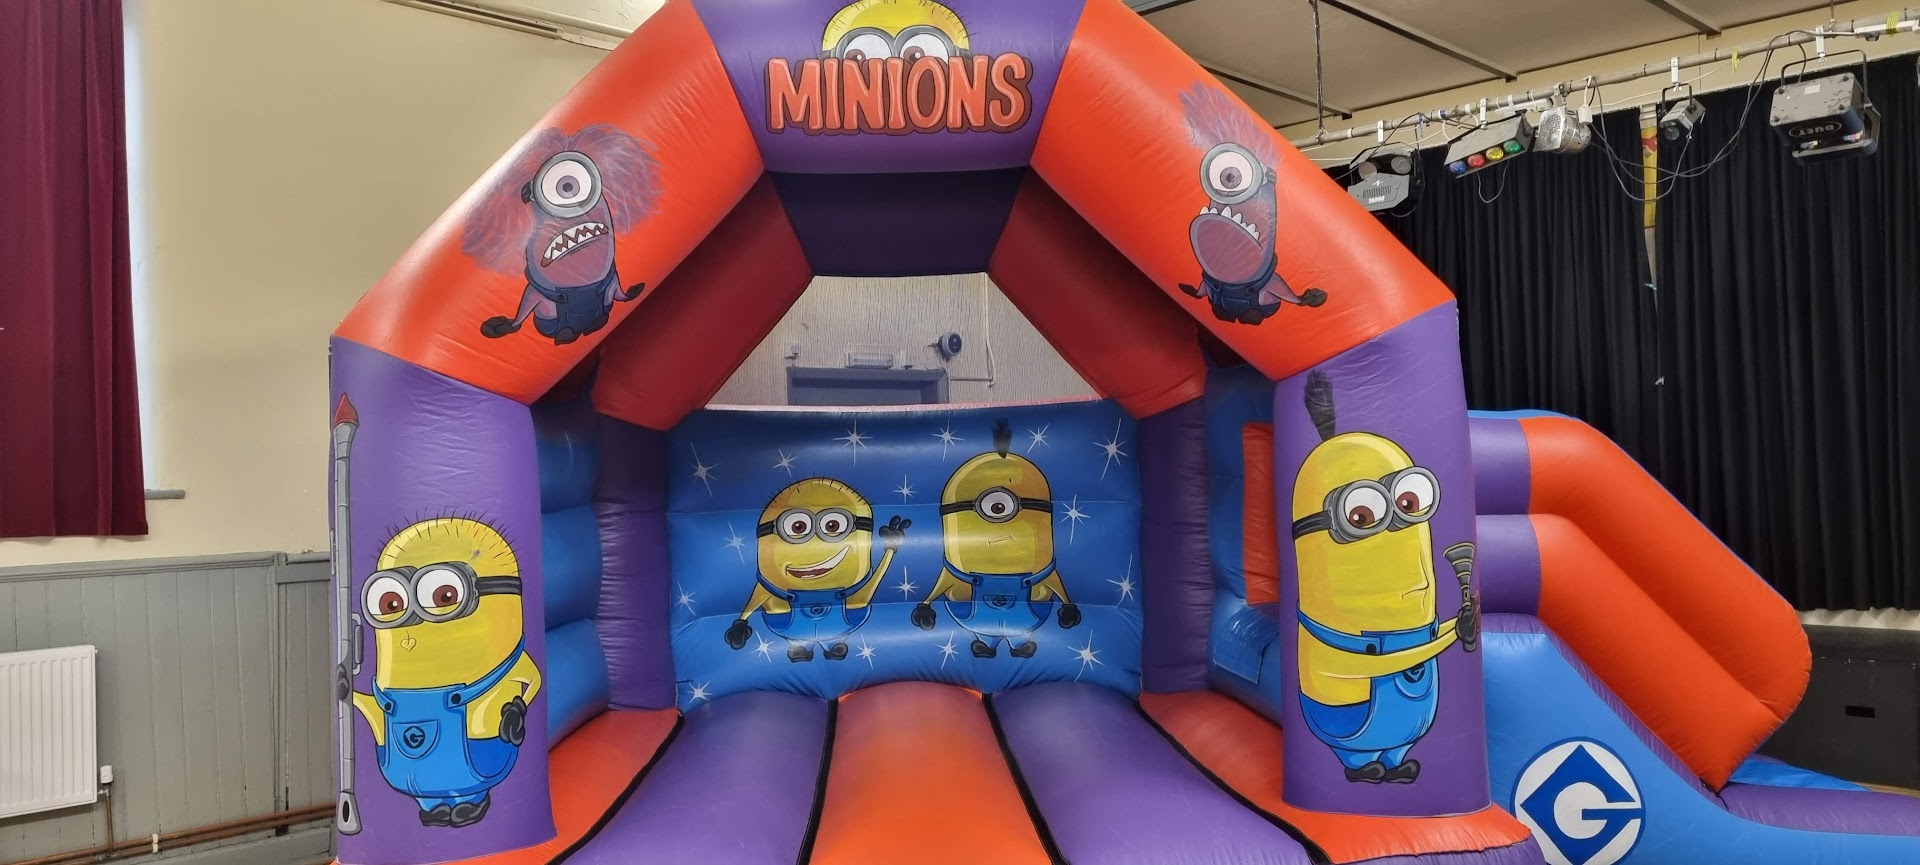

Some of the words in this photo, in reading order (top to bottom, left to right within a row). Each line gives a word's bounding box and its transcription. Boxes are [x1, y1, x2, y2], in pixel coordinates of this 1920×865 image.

[767, 52, 1031, 134] MINIONS
[1799, 124, 1835, 136] DUET
[404, 726, 425, 748] G
[1519, 743, 1642, 865] G
